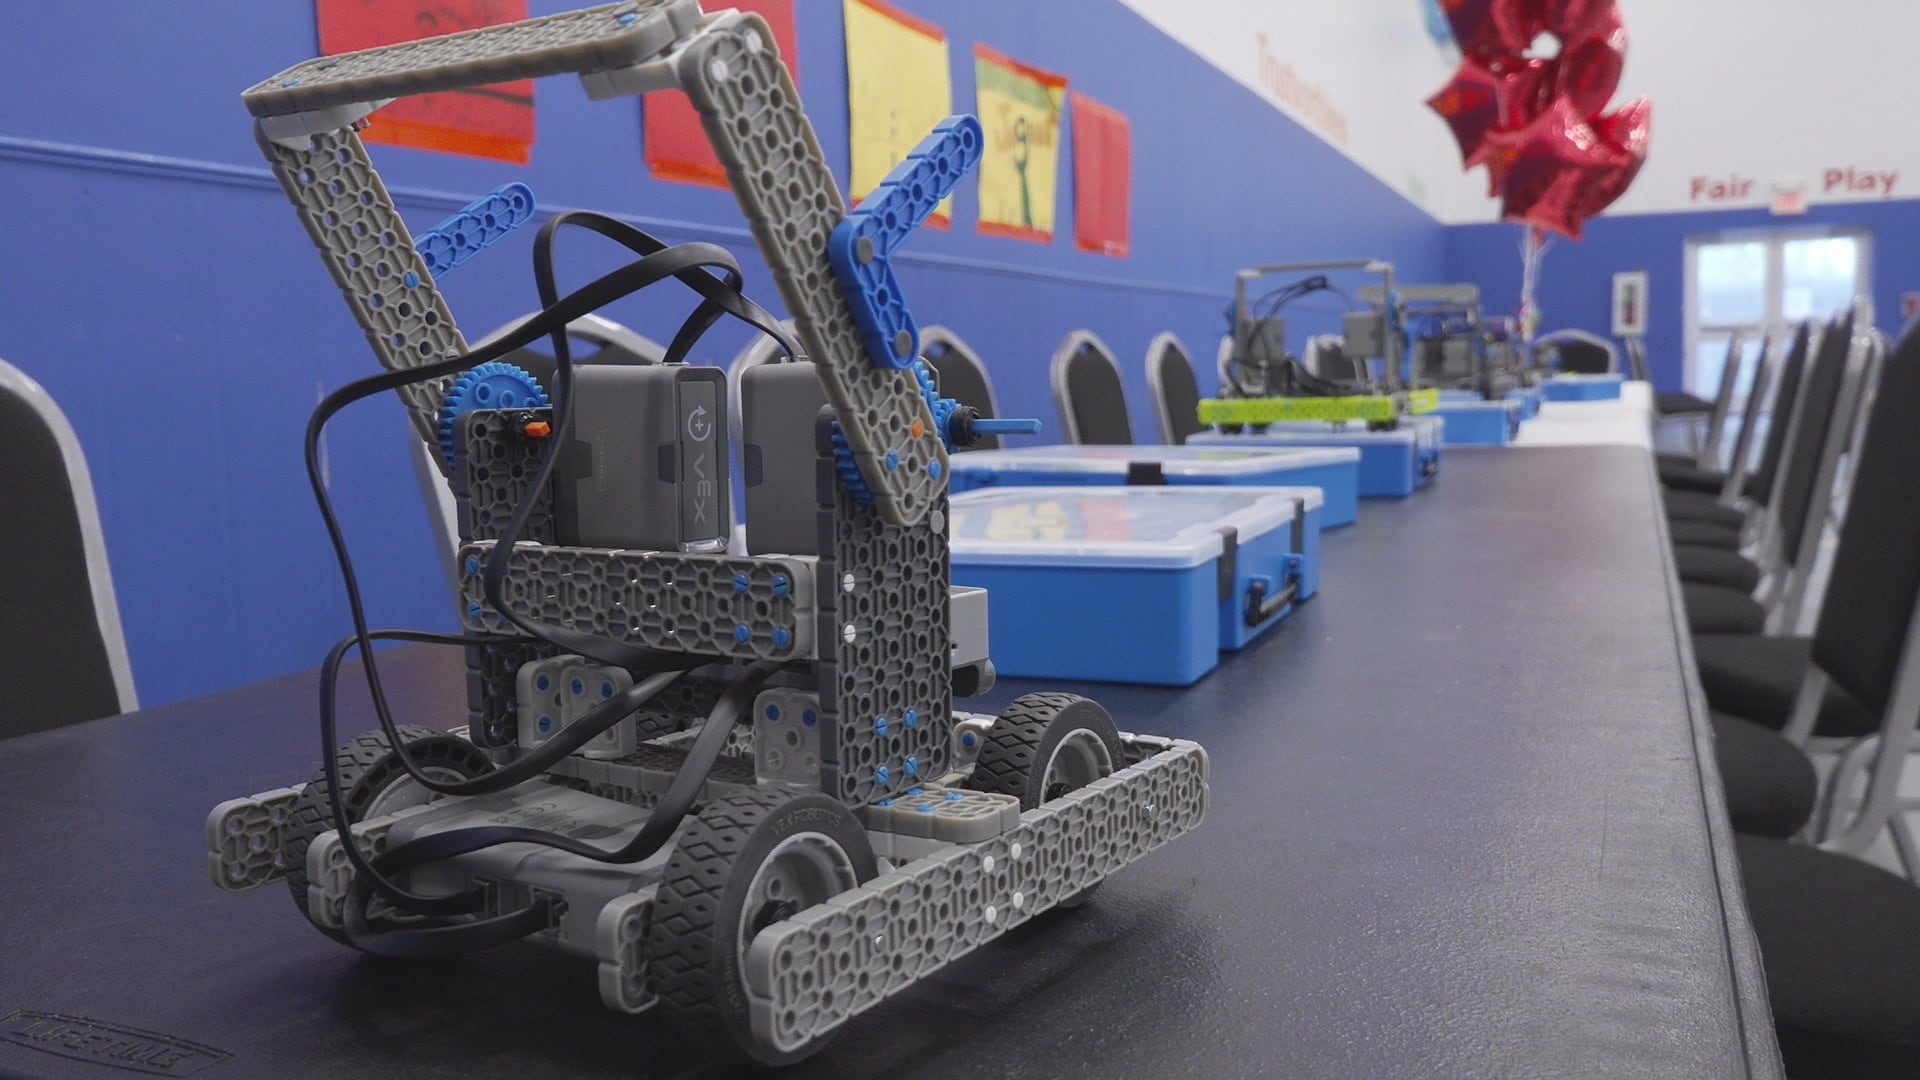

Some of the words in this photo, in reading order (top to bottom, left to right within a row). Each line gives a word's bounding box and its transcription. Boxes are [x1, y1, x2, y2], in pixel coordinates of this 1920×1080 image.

[1690, 173, 1753, 200] Fair
[1823, 165, 1899, 194] Play
[694, 453, 711, 524] VEX
